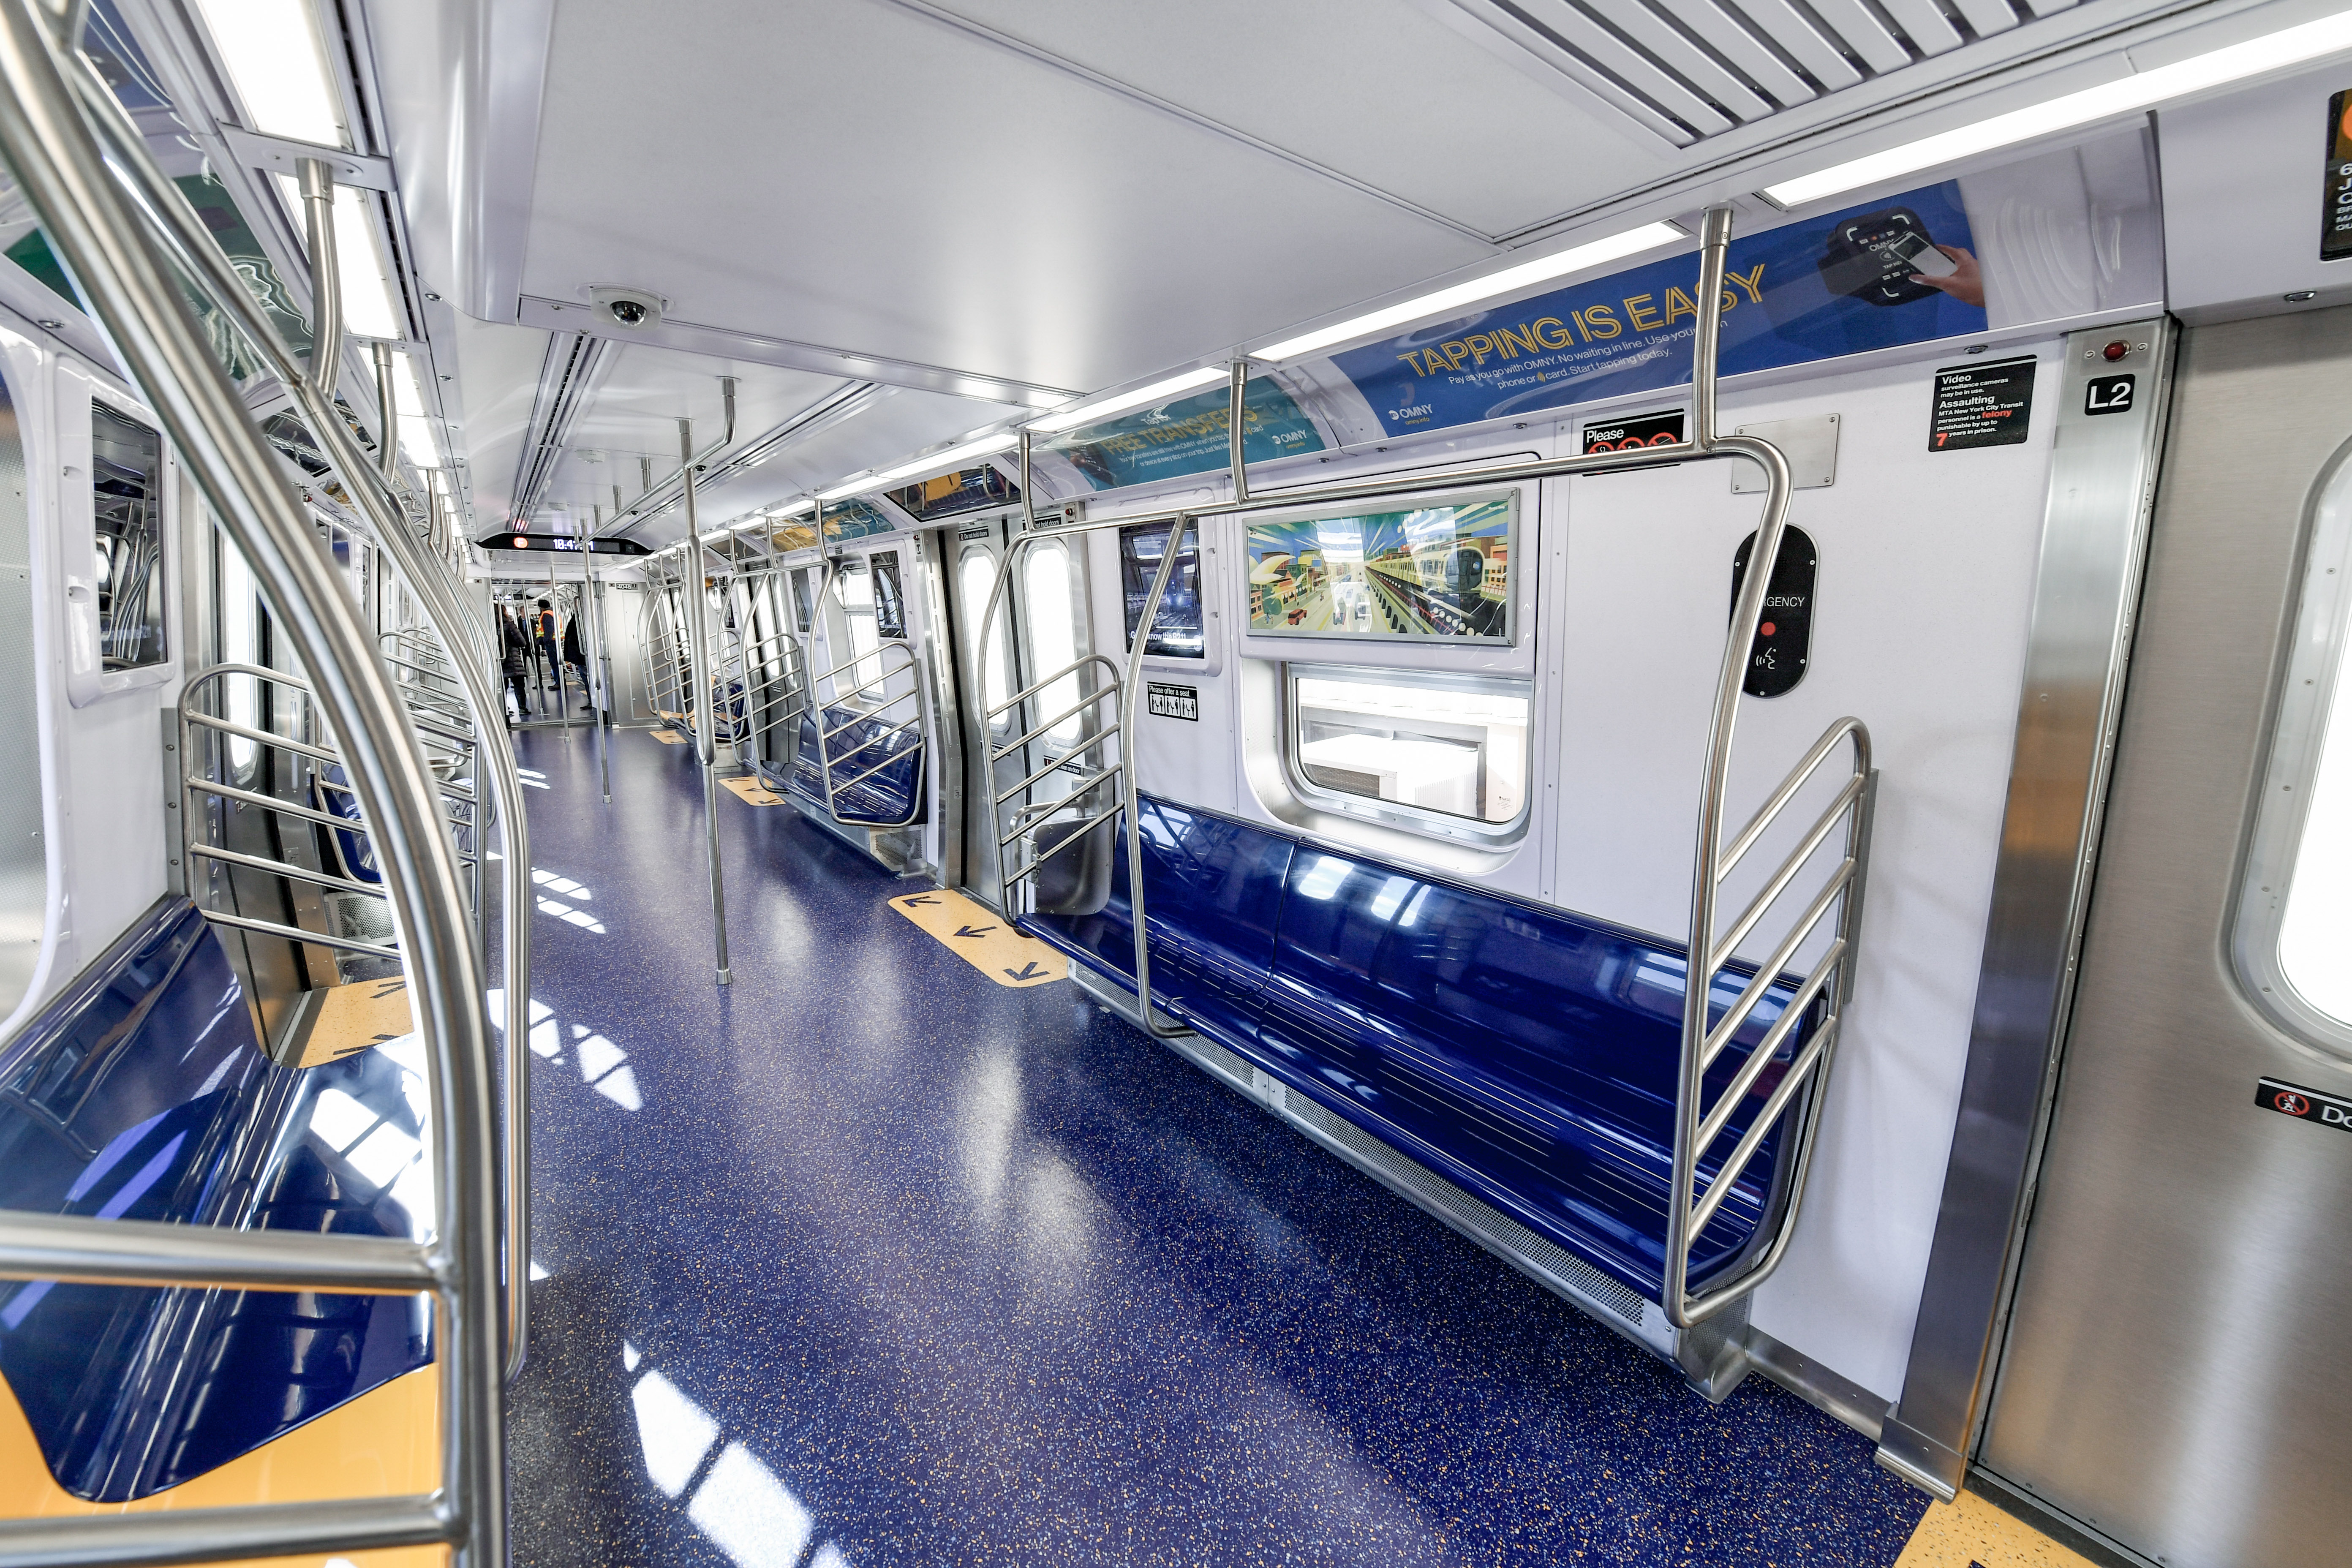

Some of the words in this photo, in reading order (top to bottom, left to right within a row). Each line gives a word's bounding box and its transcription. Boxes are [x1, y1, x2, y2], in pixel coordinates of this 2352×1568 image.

[1396, 317, 1574, 377] TAPPING
[1571, 305, 1622, 343] IS
[1448, 374, 1466, 385] Pay
[1465, 373, 1476, 381] as
[1476, 370, 1492, 384] you
[1492, 369, 1504, 381] go
[1504, 363, 1523, 374] with
[1524, 355, 1558, 370] OMNY.
[1559, 353, 1574, 363] No
[1574, 345, 1612, 361] waiting
[1612, 343, 1622, 352] in
[1622, 340, 1645, 351] line.
[1645, 333, 1670, 345] Use
[1669, 327, 1696, 341] your
[1497, 376, 1526, 390] phone
[1525, 376, 1536, 384] or
[1545, 367, 1570, 380] card.
[1571, 362, 1595, 375] Start
[1595, 354, 1637, 370] tapping
[1638, 348, 1672, 362] today.
[1941, 381, 1979, 391] surveillance
[1980, 378, 2009, 386] cameras
[1942, 375, 1971, 384] Video
[2088, 382, 2131, 409] L2
[1939, 396, 1995, 409] Assaulting
[2000, 401, 2024, 409] Transit
[1399, 404, 1432, 418] OMNY
[1938, 415, 1969, 425] personnel
[1982, 409, 2012, 418] felony
[1141, 416, 1159, 425] Tap
[1937, 422, 1971, 432] punishable
[1280, 429, 1307, 443] OMNY
[1587, 429, 1624, 444] Please
[1936, 432, 1949, 447] 7
[1949, 430, 1966, 438] years
[1974, 427, 1997, 435] prison.
[1100, 432, 1147, 455] FREE
[1180, 441, 1196, 449] OMNY
[553, 538, 594, 551] 10:4
[1763, 596, 1805, 607] GENCY
[1149, 685, 1163, 694] Please
[1164, 687, 1175, 695] offer
